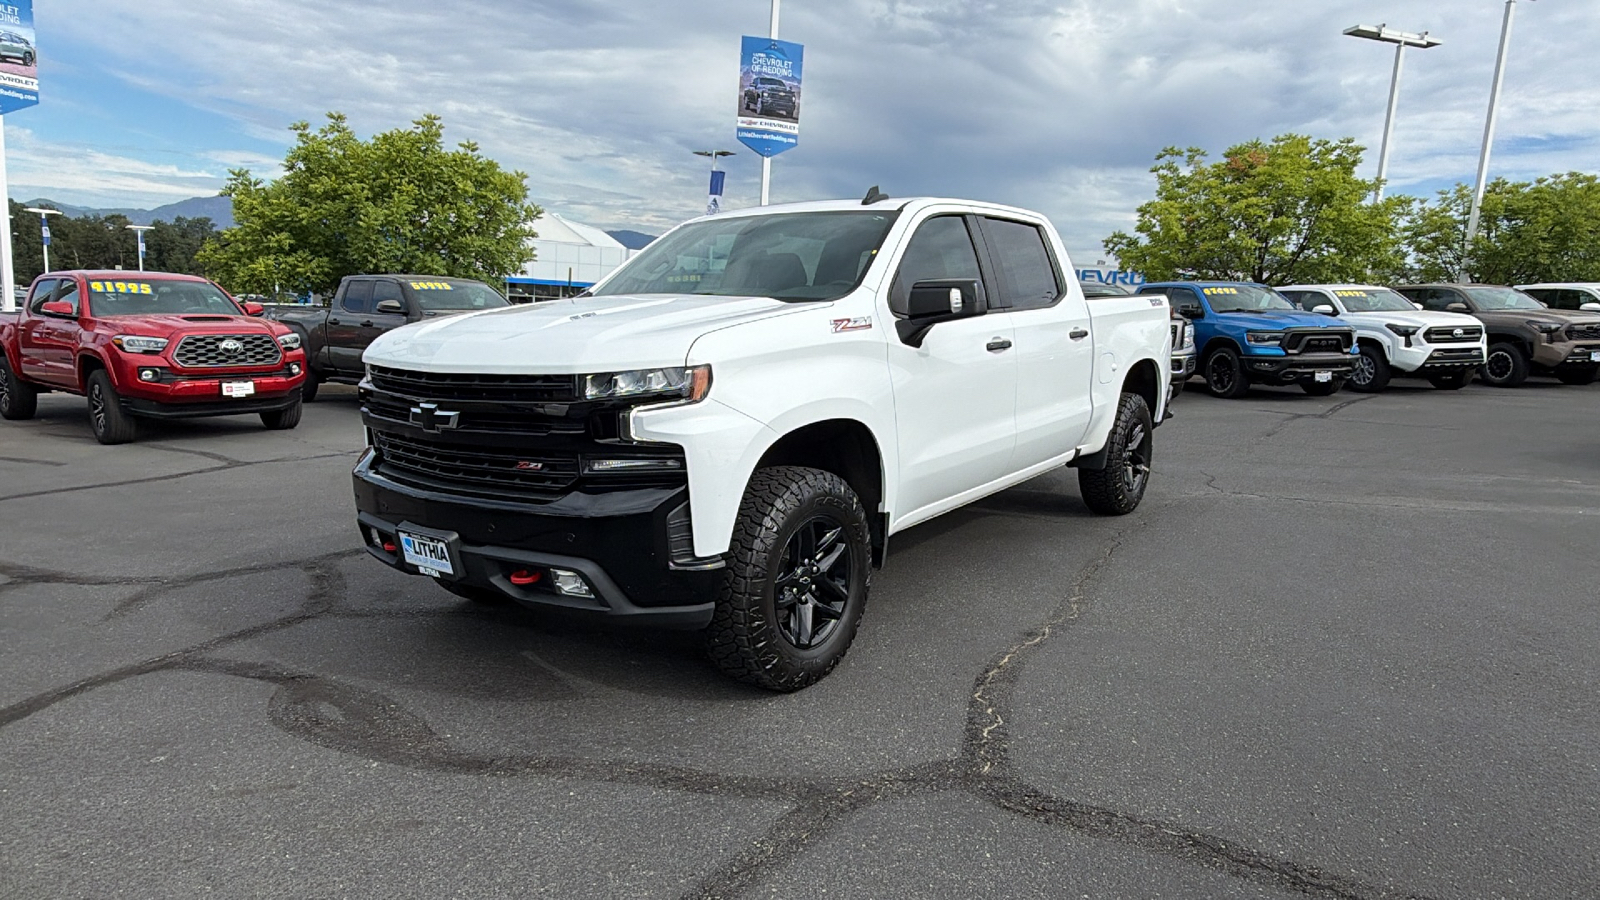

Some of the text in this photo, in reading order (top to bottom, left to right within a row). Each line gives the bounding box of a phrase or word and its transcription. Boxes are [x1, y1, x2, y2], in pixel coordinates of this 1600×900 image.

[751, 56, 793, 69] CHEVROLET
[751, 64, 793, 77] OF REDDING
[759, 121, 796, 131] CHEVROLET
[829, 316, 872, 334] Z71
[515, 461, 544, 470] Z71
[412, 540, 449, 562] LITHIA
